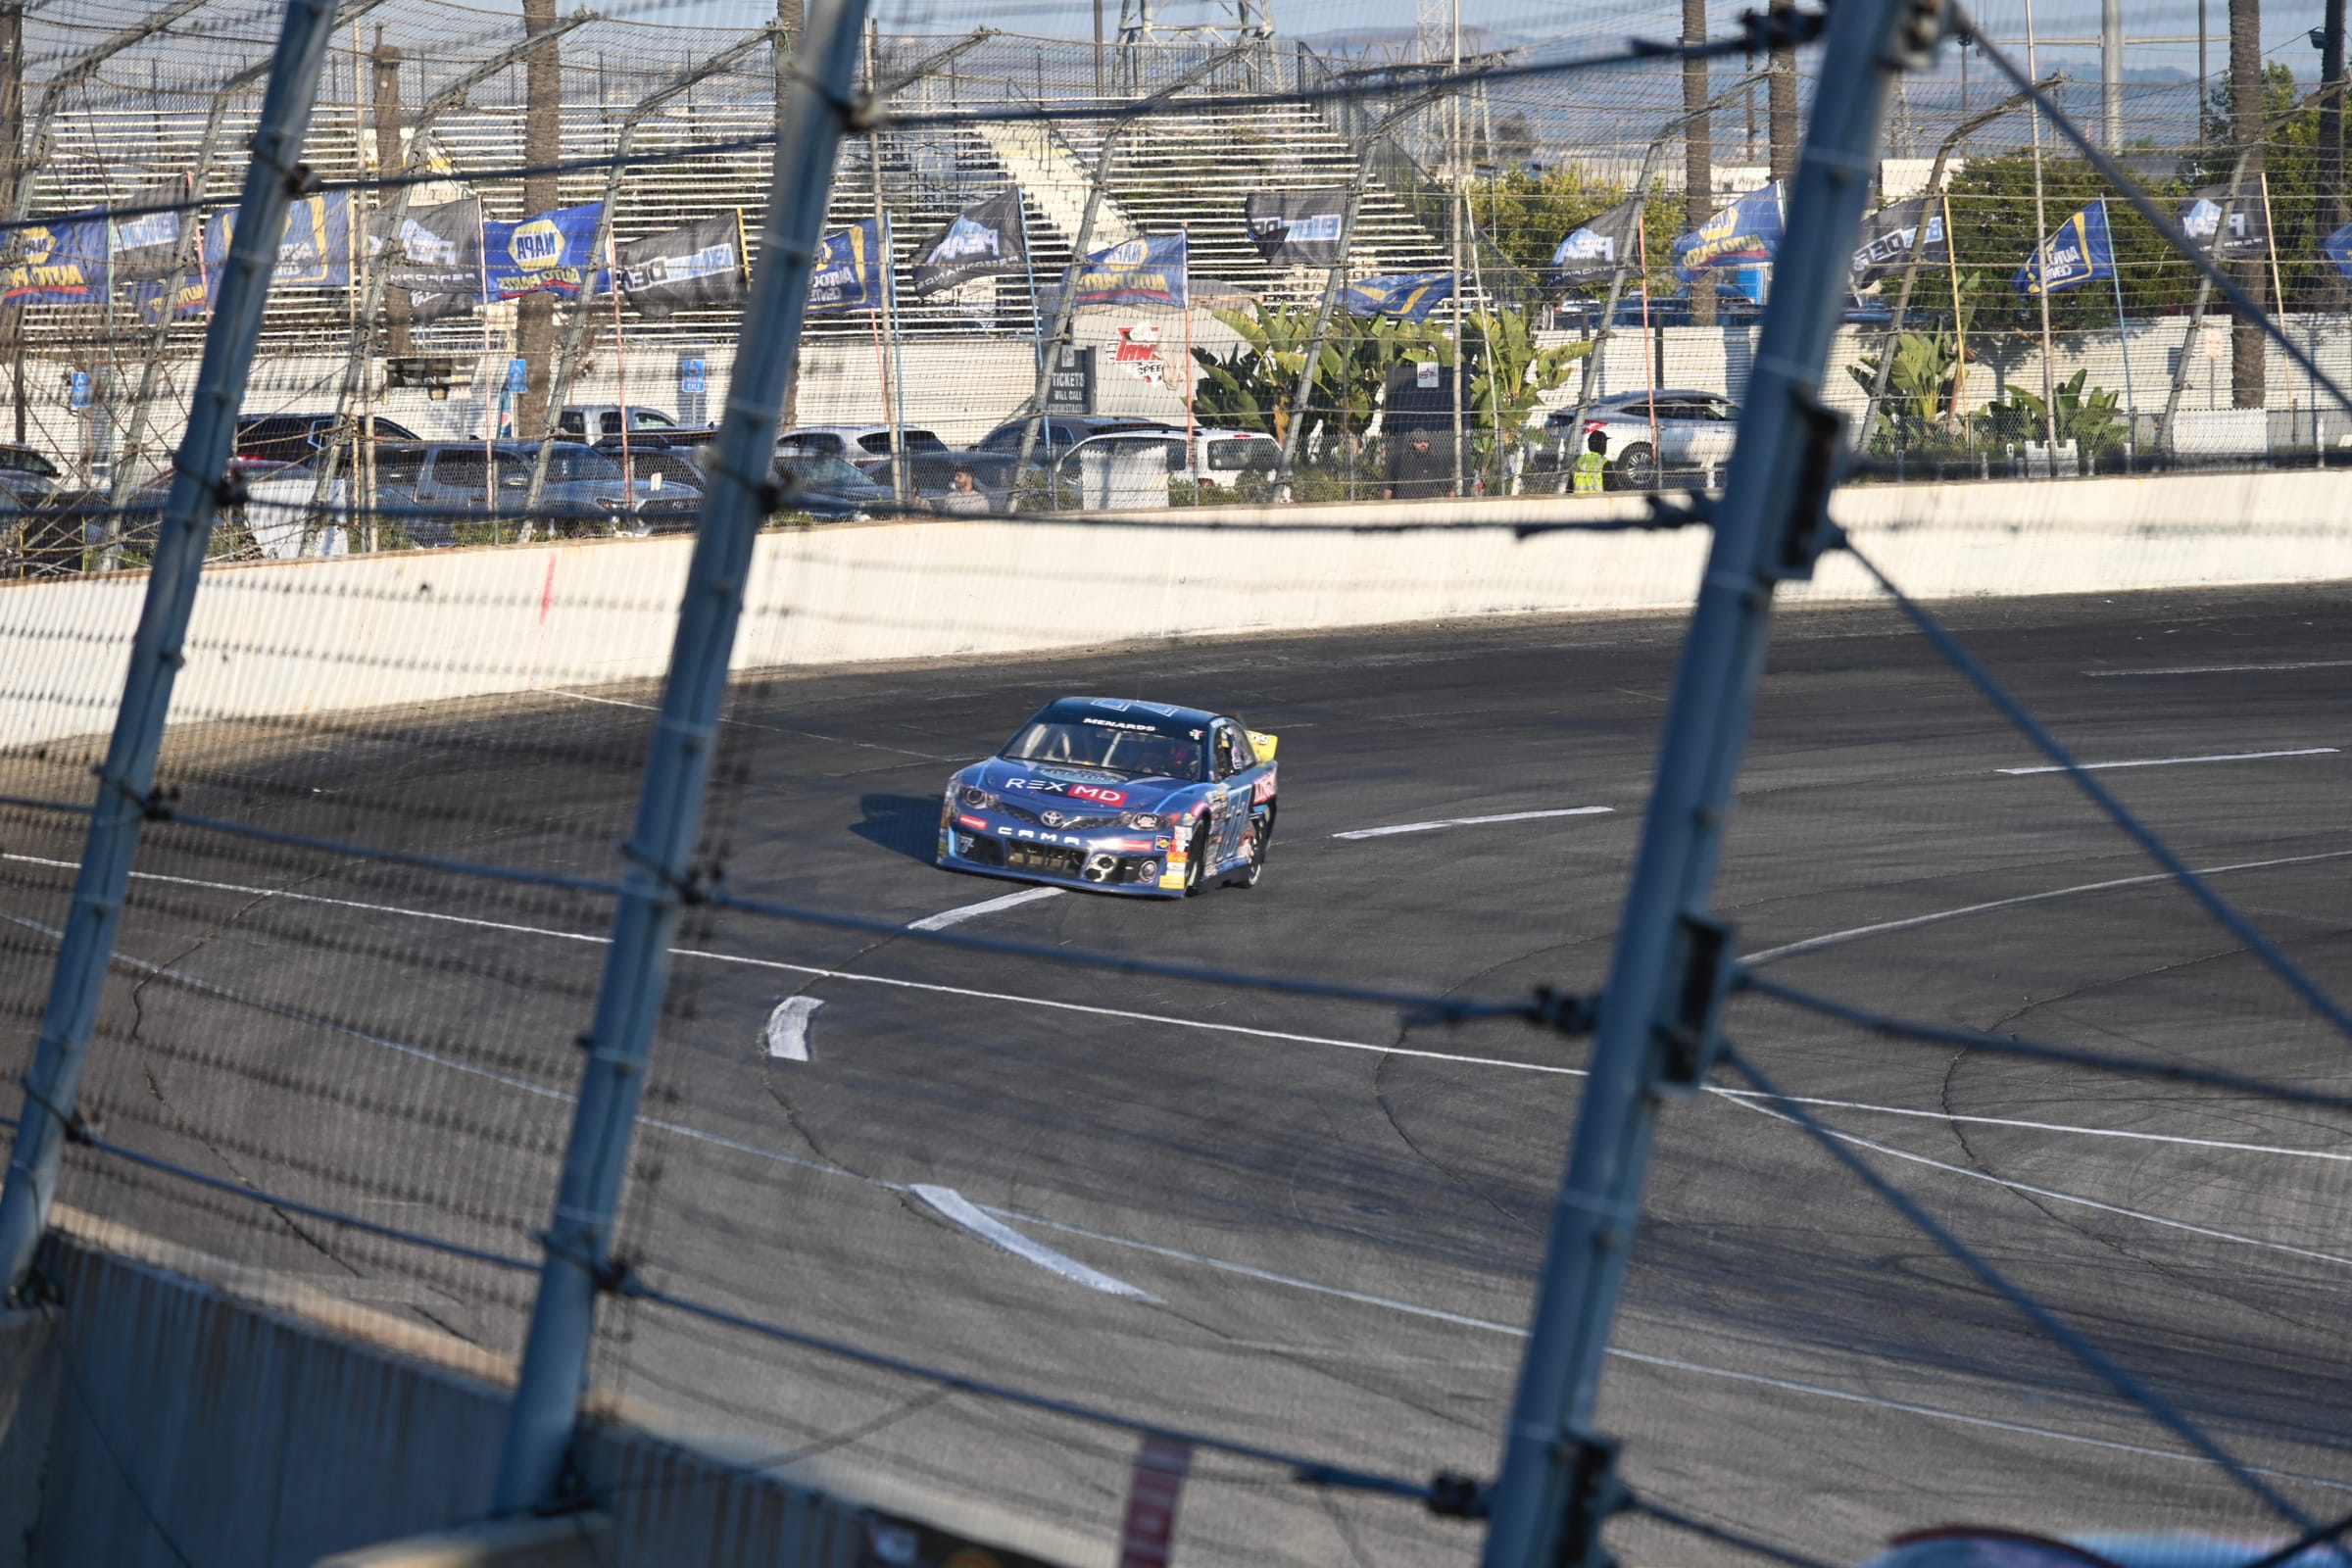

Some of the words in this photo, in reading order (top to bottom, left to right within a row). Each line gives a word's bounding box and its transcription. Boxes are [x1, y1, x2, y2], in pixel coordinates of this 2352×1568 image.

[1052, 372, 1086, 388] TICKETS
[1082, 717, 1157, 732] MENARDS
[1004, 777, 1067, 792] REX
[1073, 785, 1121, 802] MD
[997, 826, 1081, 846] CAMR
